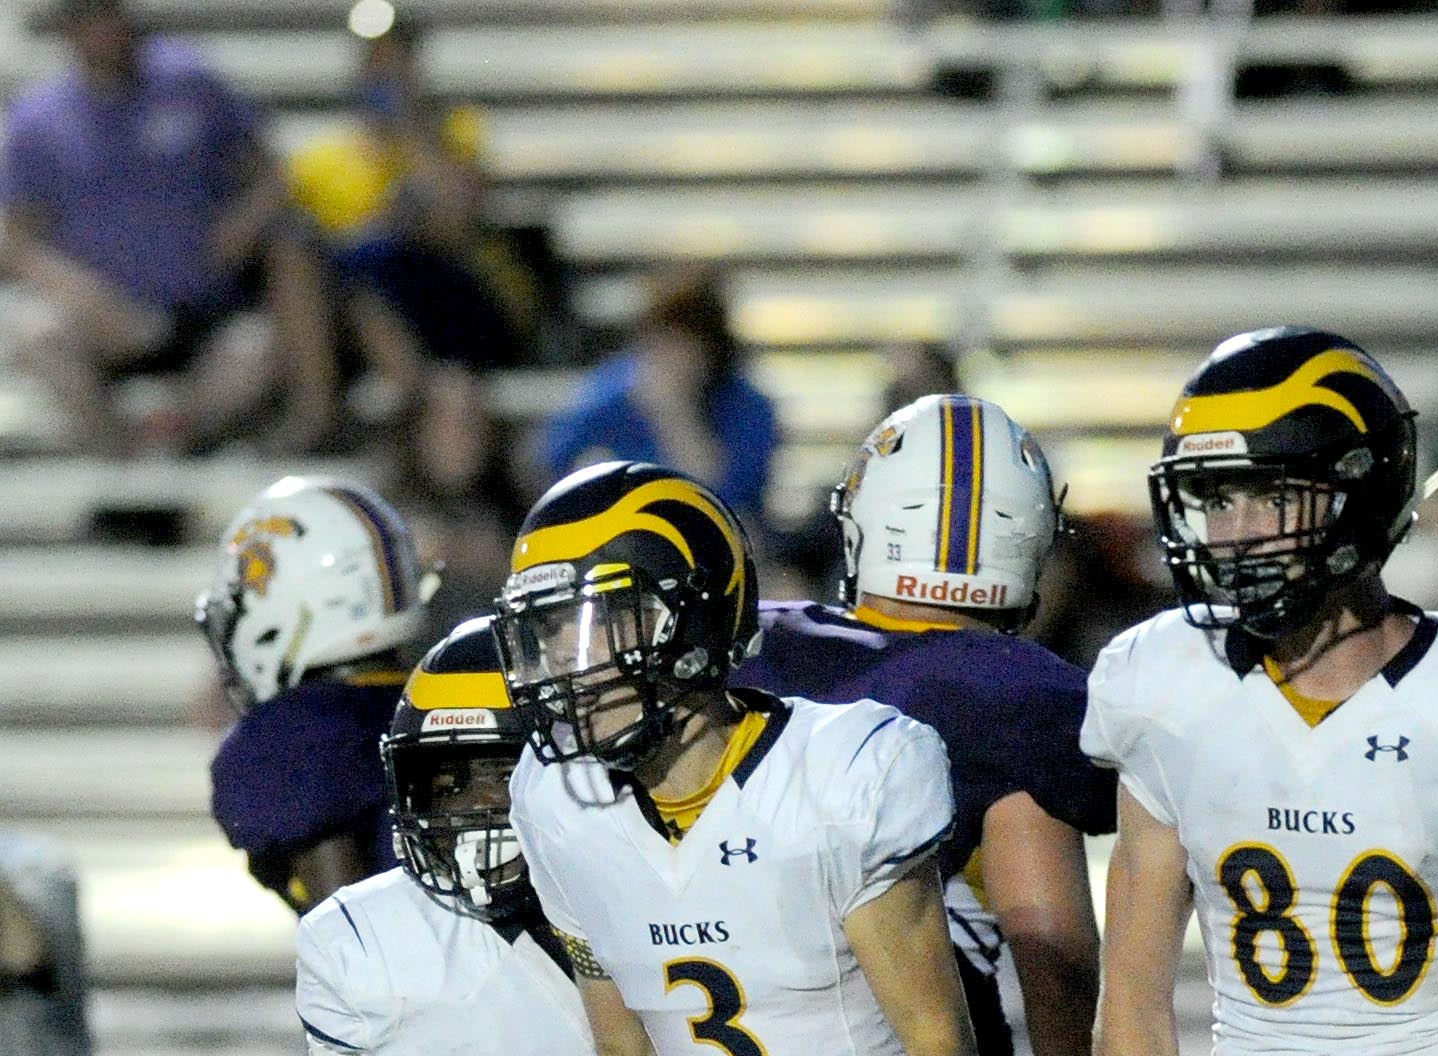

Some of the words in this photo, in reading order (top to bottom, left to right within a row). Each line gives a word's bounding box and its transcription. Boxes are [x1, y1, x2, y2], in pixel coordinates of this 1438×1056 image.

[887, 542, 902, 561] 33
[895, 574, 1008, 607] Riddell
[430, 713, 486, 726] Riddell
[1267, 807, 1356, 834] BUCKS
[648, 920, 730, 946] BUCKS
